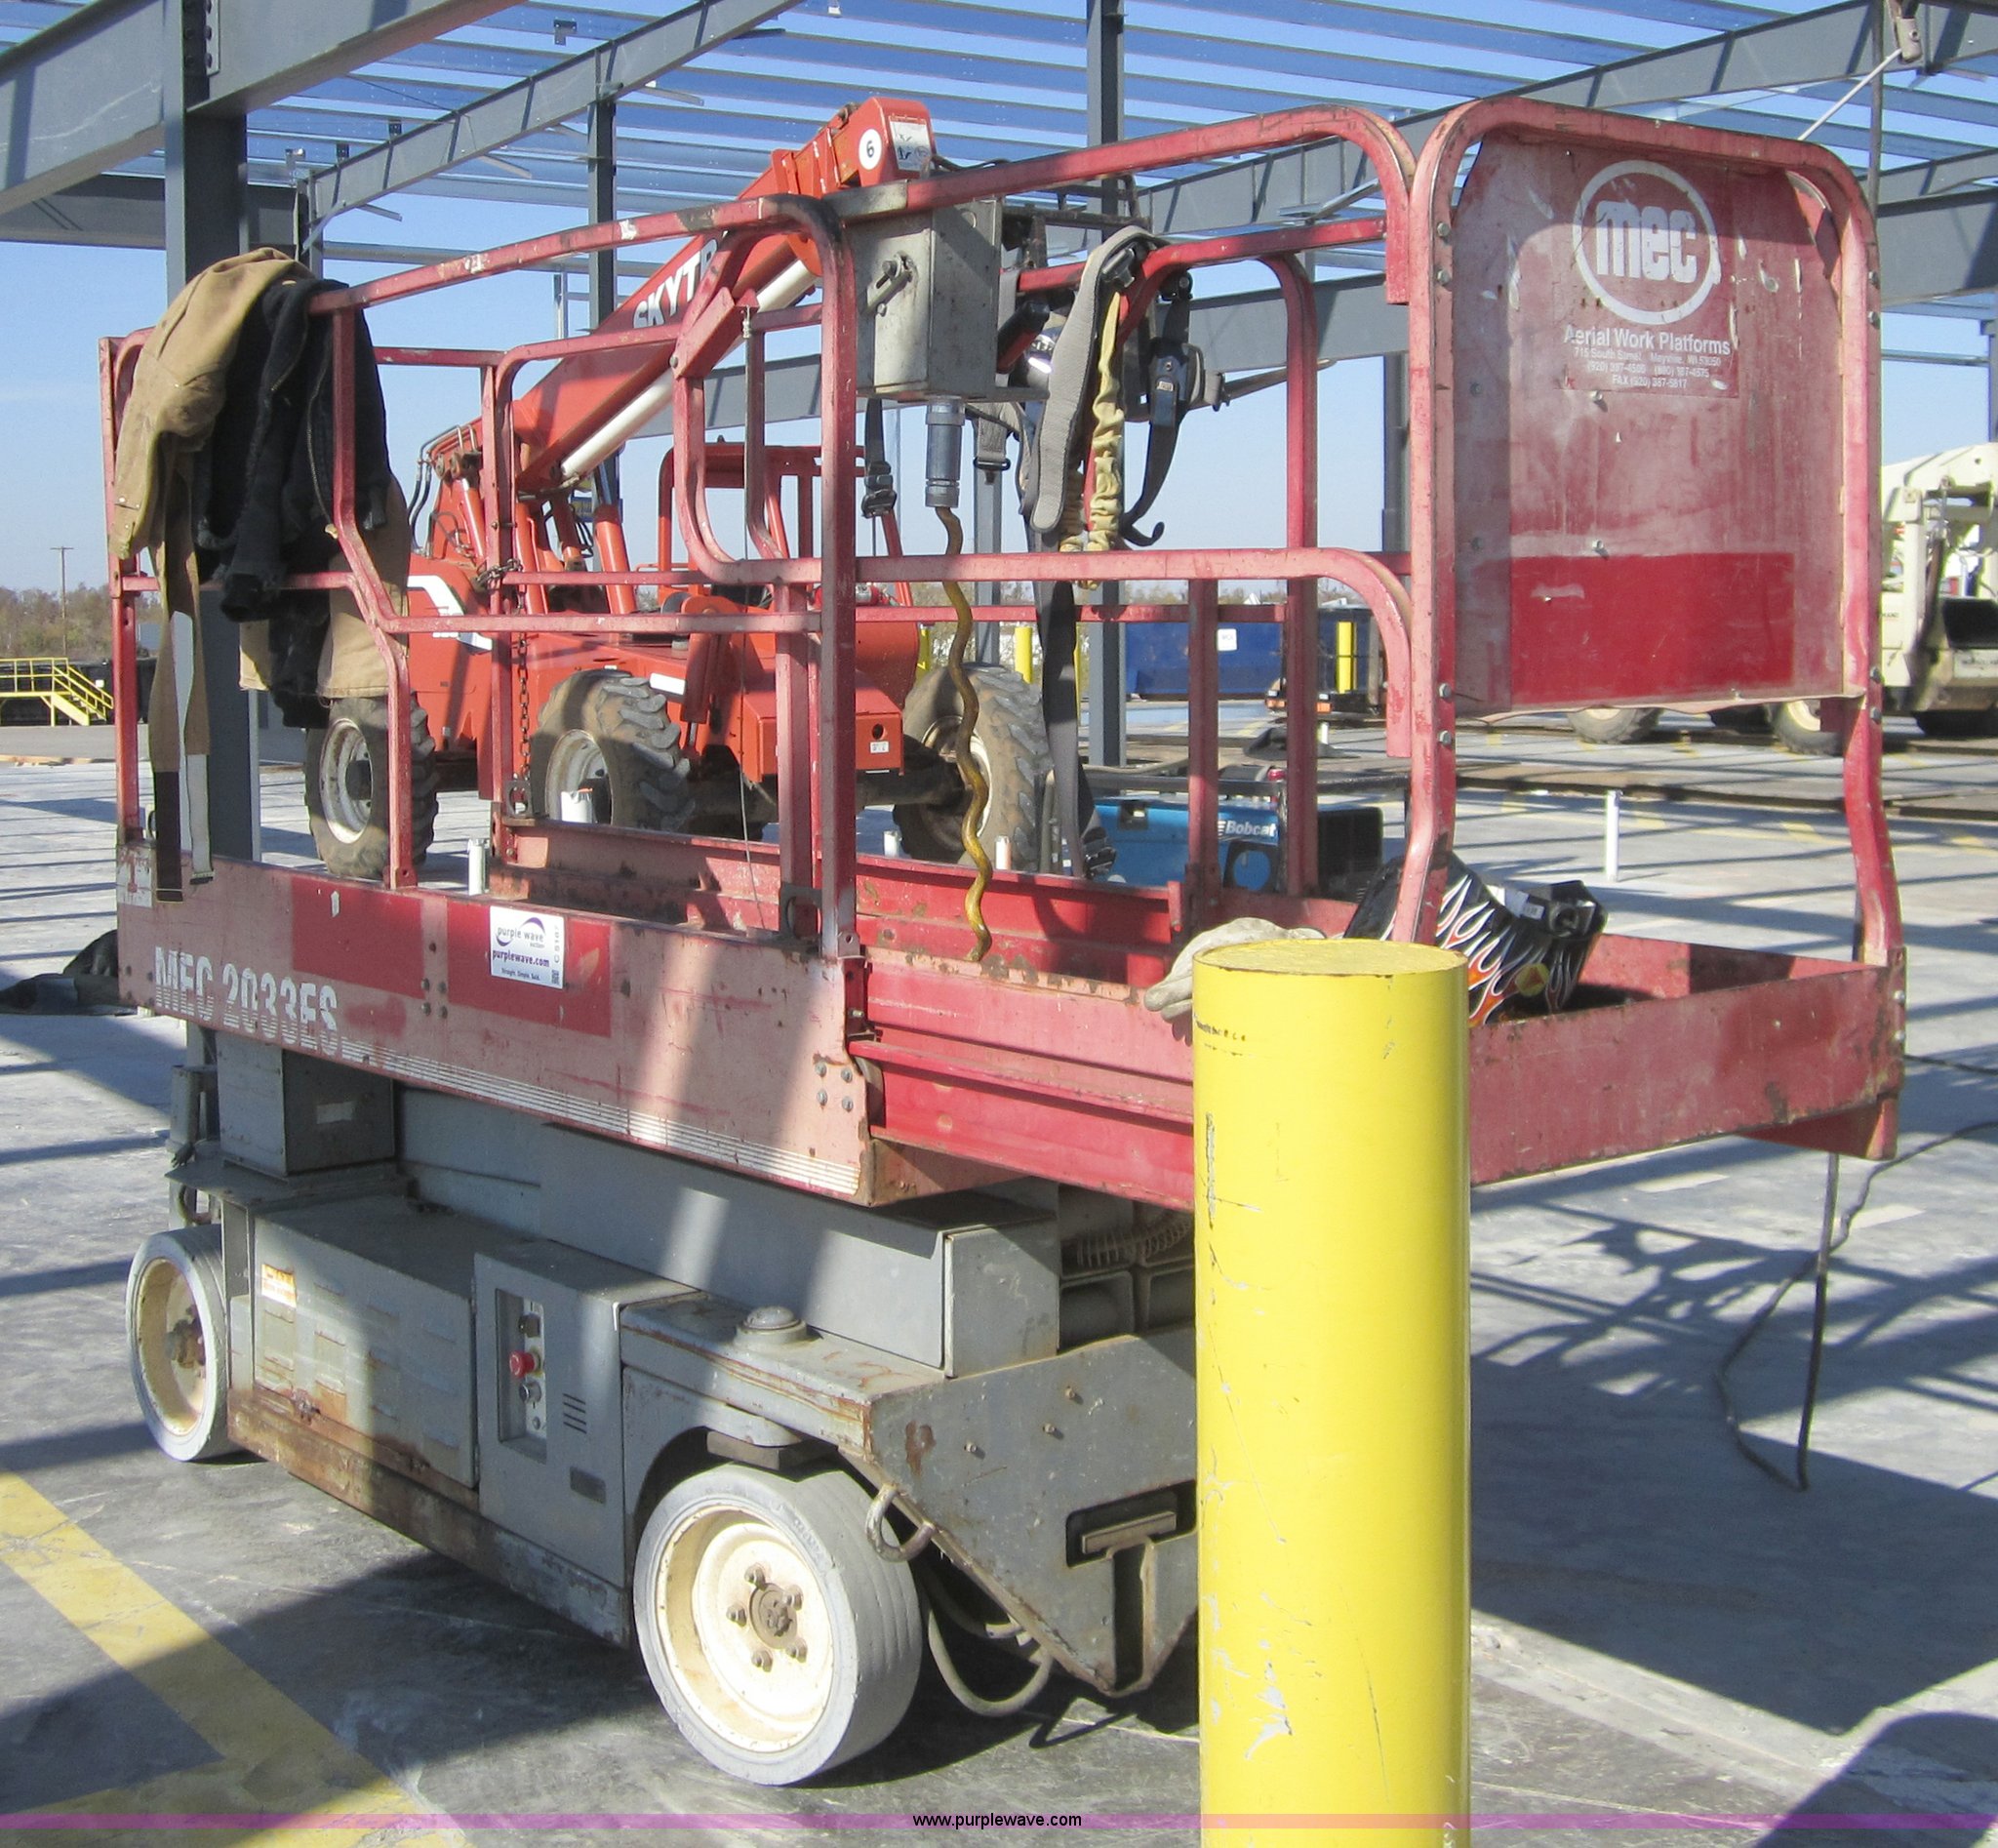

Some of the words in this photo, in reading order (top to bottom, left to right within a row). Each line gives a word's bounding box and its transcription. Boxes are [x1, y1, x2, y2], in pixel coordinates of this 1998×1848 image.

[866, 140, 875, 158] 6
[1564, 324, 1610, 346] Aerial
[1615, 328, 1656, 349] Work
[1659, 332, 1731, 355] Platforms
[1225, 820, 1278, 837] Bobcat
[497, 926, 522, 940] purple
[524, 932, 544, 943] wave
[492, 949, 550, 968] purplewave.com
